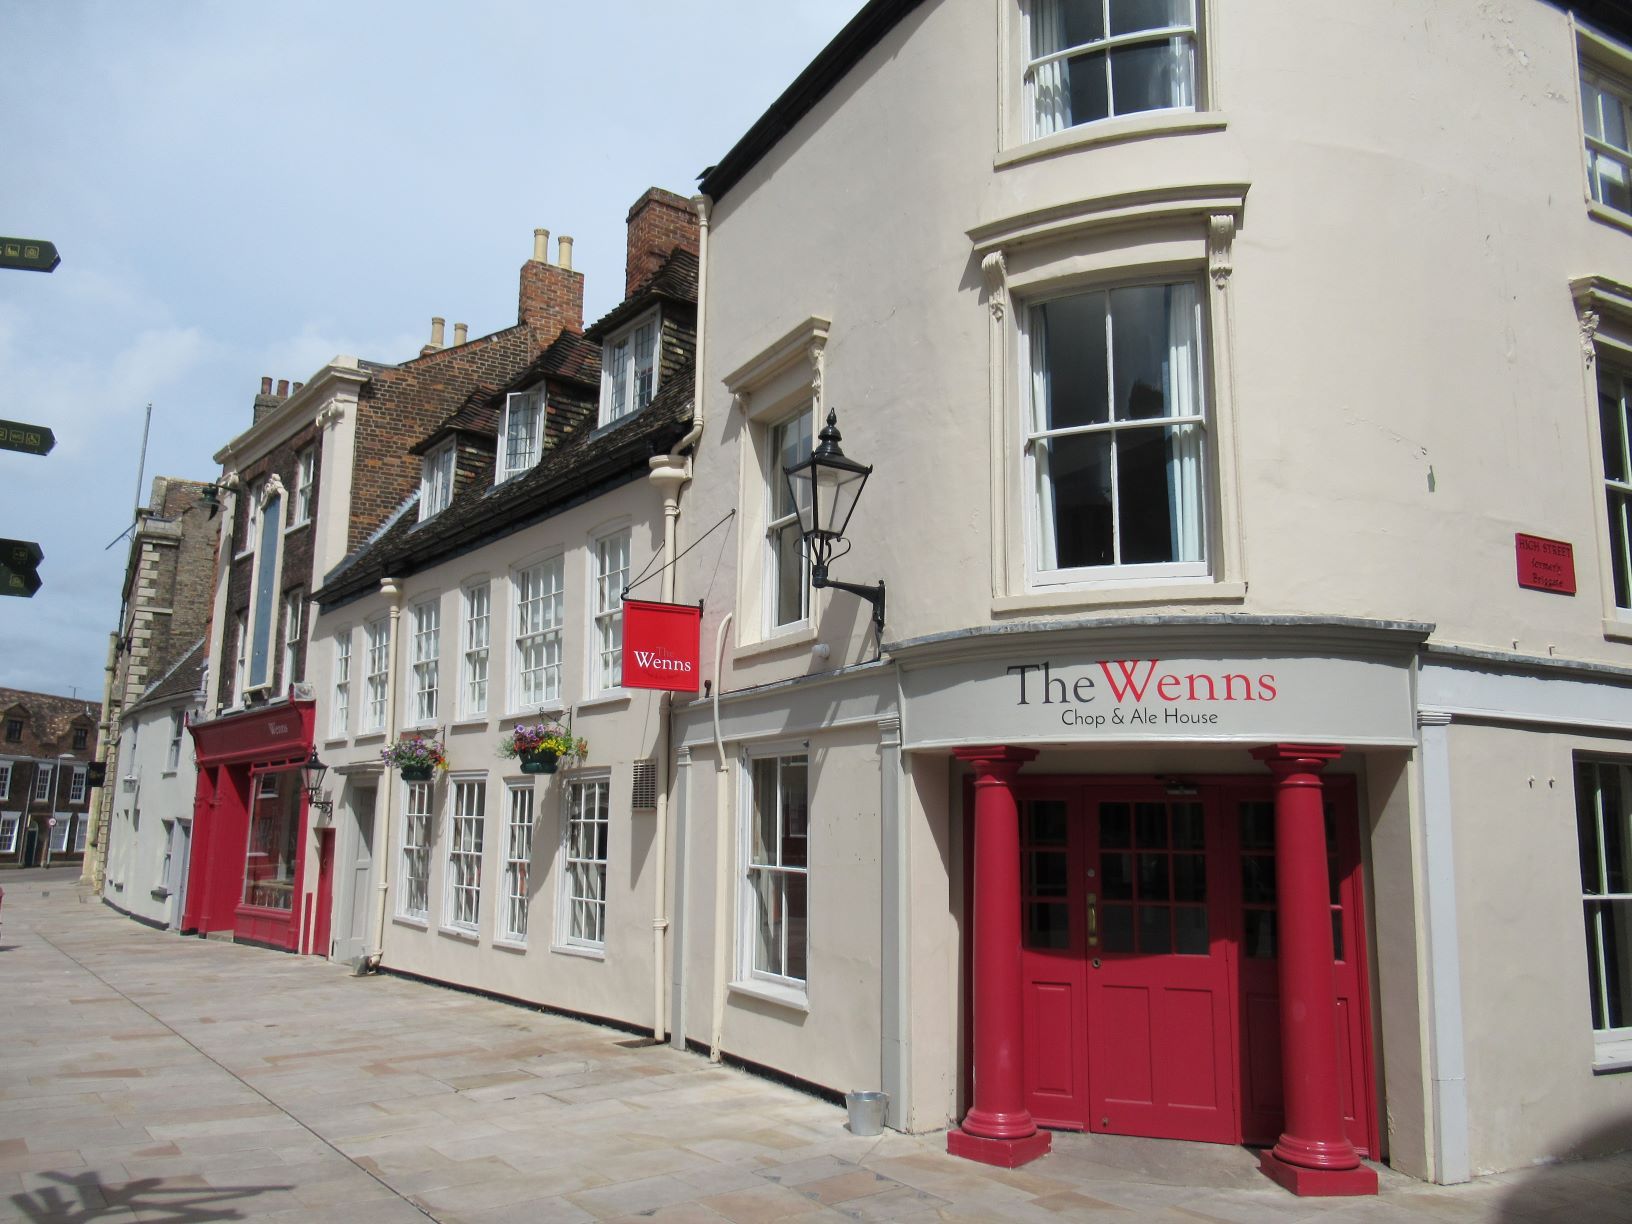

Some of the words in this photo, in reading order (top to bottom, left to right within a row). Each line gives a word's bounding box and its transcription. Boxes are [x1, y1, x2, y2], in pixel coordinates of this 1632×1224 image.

[1520, 539, 1539, 552] HIGH
[1543, 543, 1570, 557] STREET
[633, 650, 692, 672] Wenns
[1006, 661, 1095, 705] The
[1095, 659, 1278, 703] Wenns
[1061, 709, 1105, 728] Chop
[1111, 708, 1125, 725] &
[1130, 708, 1158, 724] Ale
[1164, 708, 1218, 724] House
